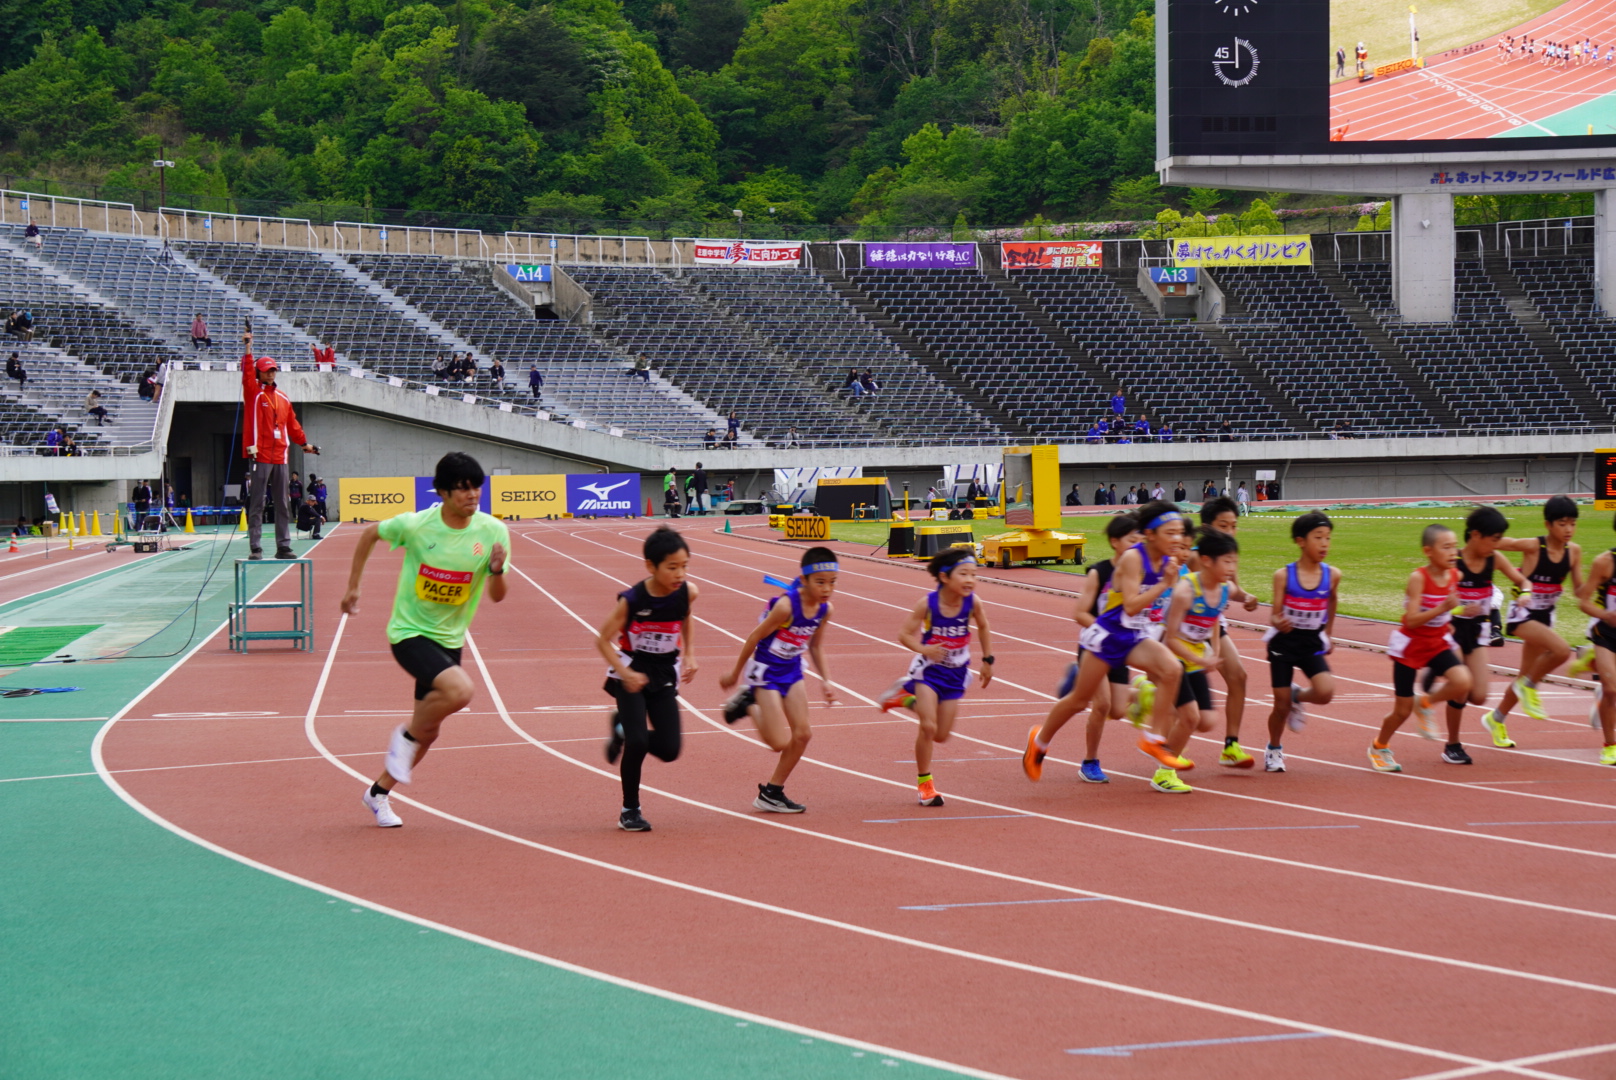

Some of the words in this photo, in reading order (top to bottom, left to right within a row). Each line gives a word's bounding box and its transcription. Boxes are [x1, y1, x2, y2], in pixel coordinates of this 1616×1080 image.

[1214, 47, 1229, 59] 45
[1376, 60, 1413, 76] SEIKO
[1046, 245, 1090, 256] 夢に向かって
[515, 266, 543, 280] A14
[1158, 269, 1188, 282] A13
[349, 493, 405, 504] SEIKO
[501, 490, 556, 502] SEIKO
[786, 517, 826, 538] SEIKO
[423, 580, 463, 597] PACER
[931, 625, 967, 637] RISE
